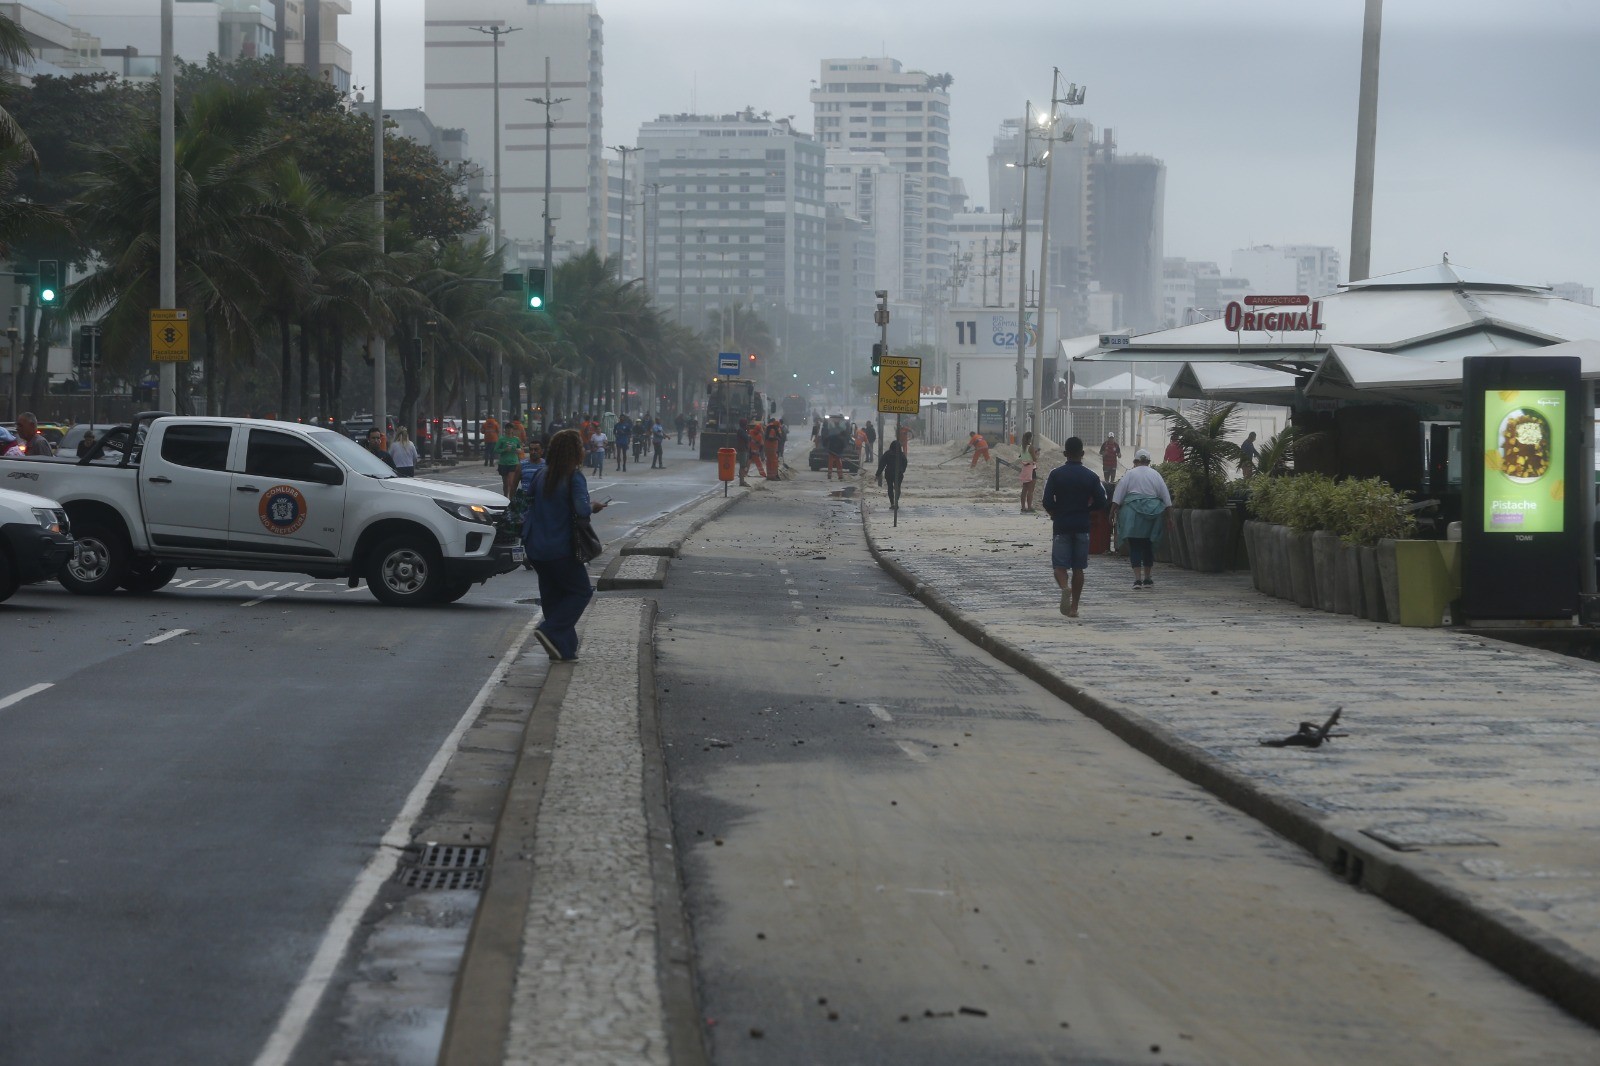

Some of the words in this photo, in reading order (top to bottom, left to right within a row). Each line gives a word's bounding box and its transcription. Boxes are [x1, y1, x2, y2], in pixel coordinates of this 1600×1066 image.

[1226, 301, 1326, 332] ORIGINAL
[956, 321, 976, 345] 11
[883, 358, 909, 367] Atenção
[880, 397, 918, 406] Fiscalização
[884, 404, 915, 412] Eletrônica
[266, 486, 299, 498] COMLURB
[1492, 500, 1537, 510] Pistache
[260, 513, 270, 527] RIO
[270, 512, 306, 535] PREFEITURA
